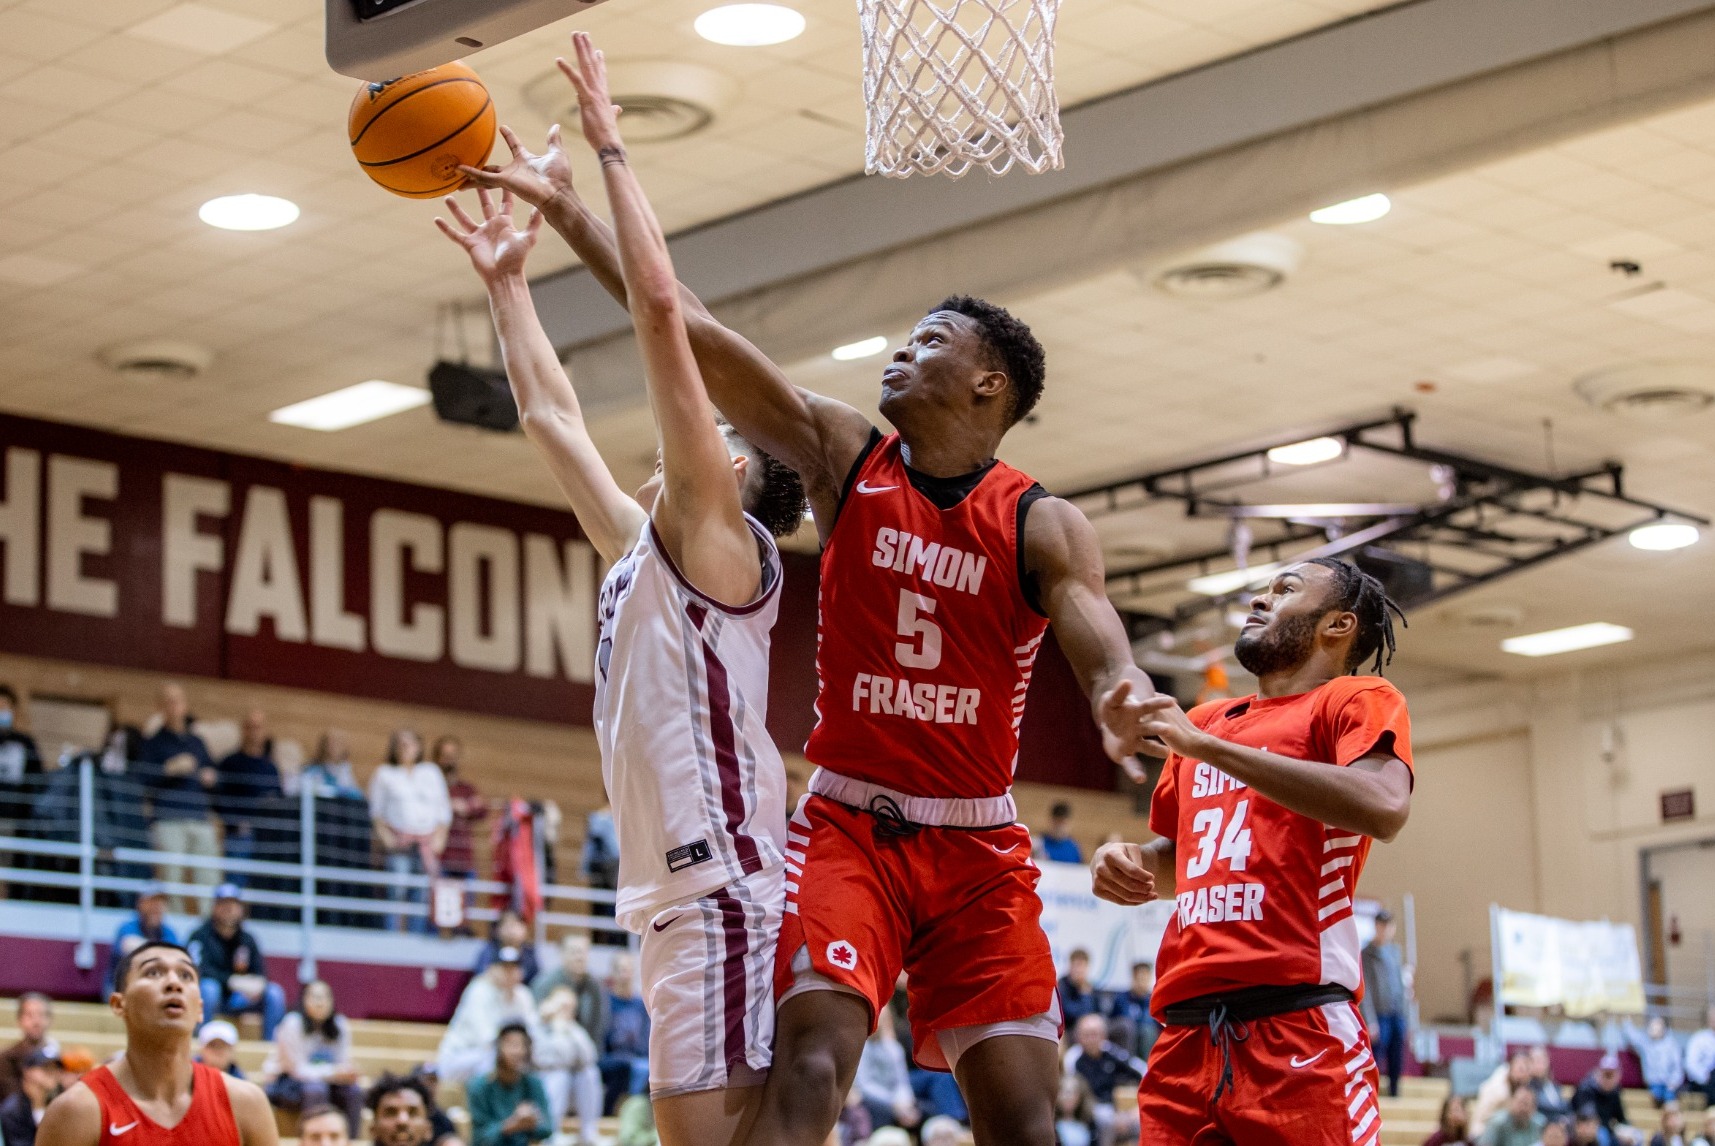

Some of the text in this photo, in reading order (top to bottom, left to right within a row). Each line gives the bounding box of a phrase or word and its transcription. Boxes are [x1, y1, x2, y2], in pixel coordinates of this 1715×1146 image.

[872, 527, 987, 595] SIMON
[895, 588, 942, 670] 5
[853, 672, 980, 725] FRASER
[695, 848, 703, 857] L
[1187, 799, 1252, 879] 34
